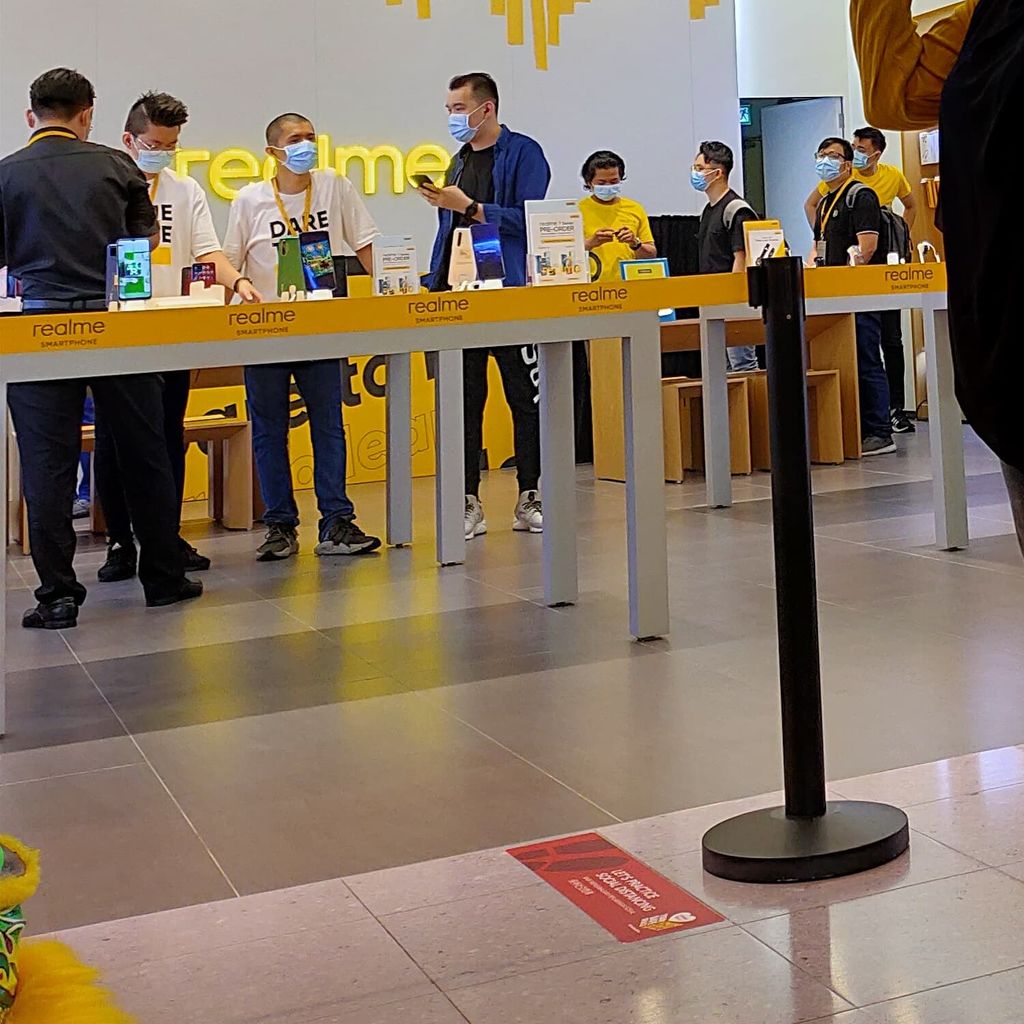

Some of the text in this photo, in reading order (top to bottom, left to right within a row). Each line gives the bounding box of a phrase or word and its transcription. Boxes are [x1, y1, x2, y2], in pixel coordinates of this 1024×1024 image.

[176, 134, 450, 201] relme
[884, 266, 934, 282] realme
[571, 286, 628, 303] realme
[408, 296, 470, 314] realme
[228, 308, 296, 326] realme
[33, 319, 105, 337] realme
[236, 326, 289, 337] SMARTPHONE
[40, 338, 98, 348] SMARTPHONE
